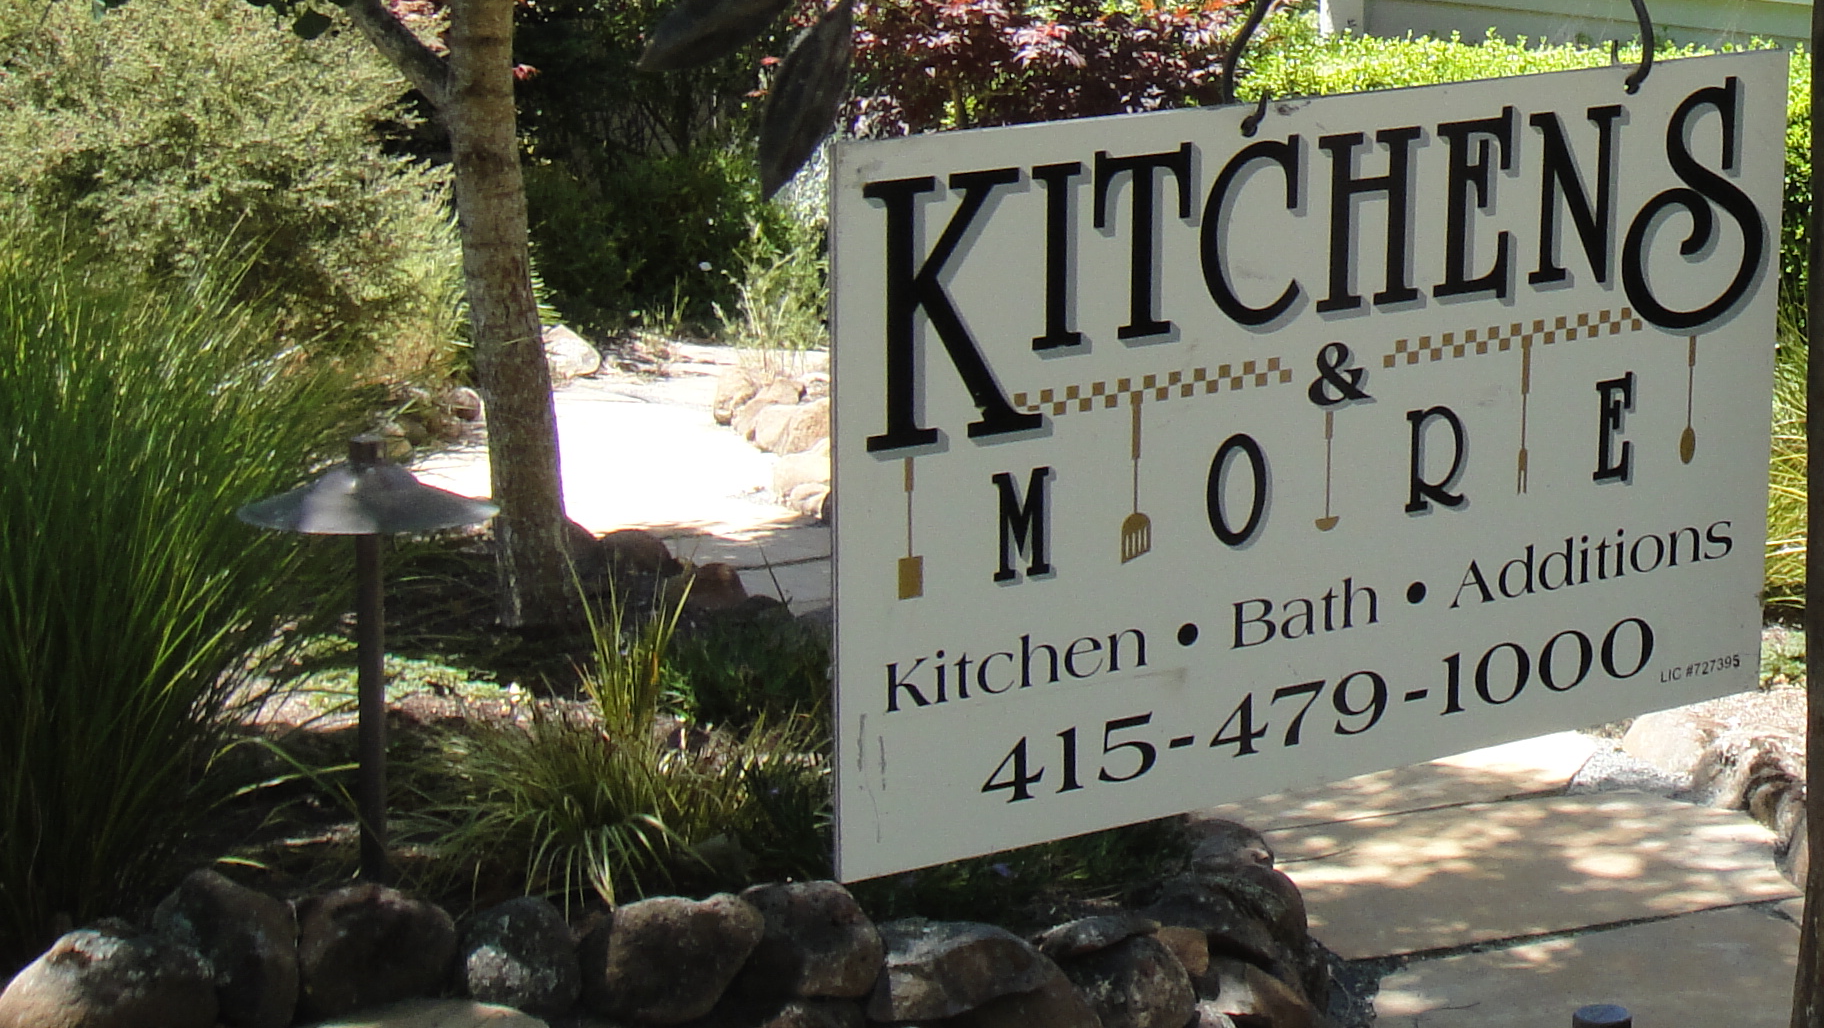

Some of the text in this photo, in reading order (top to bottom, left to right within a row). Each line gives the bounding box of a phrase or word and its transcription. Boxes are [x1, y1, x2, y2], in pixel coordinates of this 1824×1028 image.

[863, 76, 1766, 453] KITCHENS
[1308, 342, 1372, 407] &
[992, 372, 1635, 583] MORE
[886, 520, 1733, 713] Kitchen Bath Additions
[980, 617, 1654, 804] 415-479-1000
[1660, 667, 1682, 683] LIC
